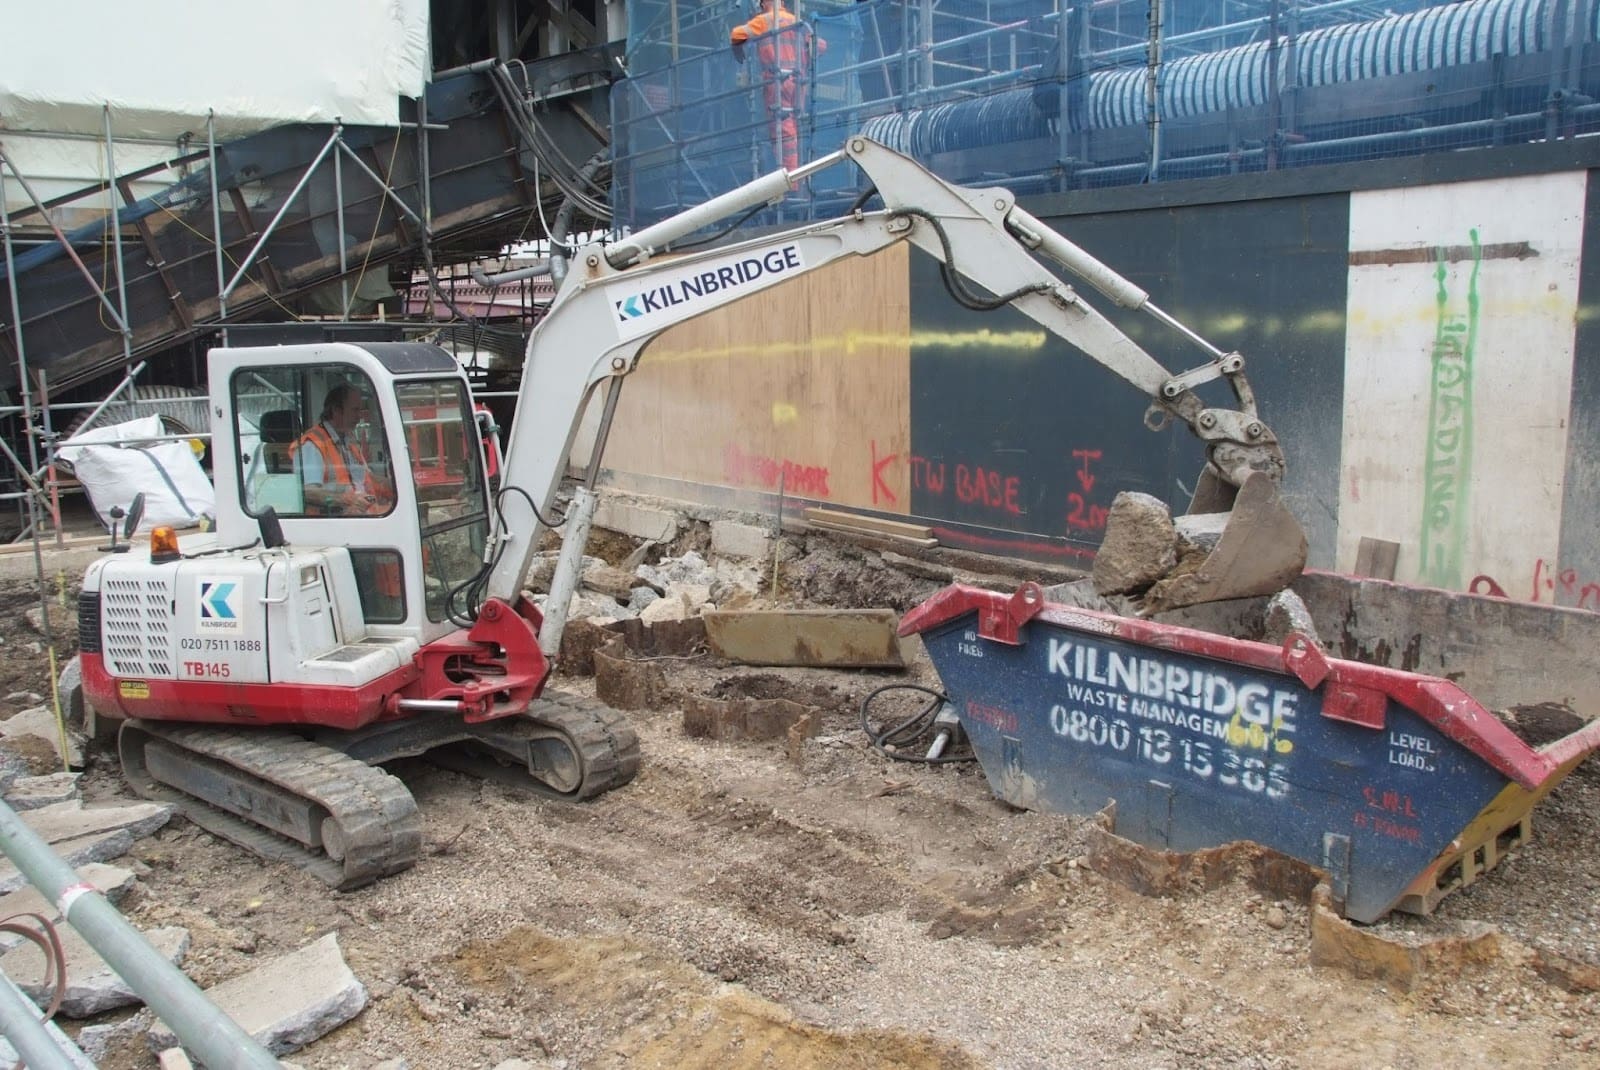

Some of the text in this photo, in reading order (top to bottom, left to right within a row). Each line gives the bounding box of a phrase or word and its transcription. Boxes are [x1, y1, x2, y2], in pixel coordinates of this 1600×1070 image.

[641, 245, 801, 313] KILNBRIDGE
[870, 439, 897, 505] K
[955, 463, 1021, 515] BASE
[201, 621, 238, 629] KILNBRIDGE
[181, 638, 261, 652] 020 7511 1888
[184, 661, 230, 678] TB145
[1048, 638, 1299, 733] KILNBRIDGE
[1067, 683, 1127, 713] WASTE
[1050, 704, 1131, 751] 0800
[1139, 726, 1171, 764] 13
[1389, 731, 1436, 754] LEVEL
